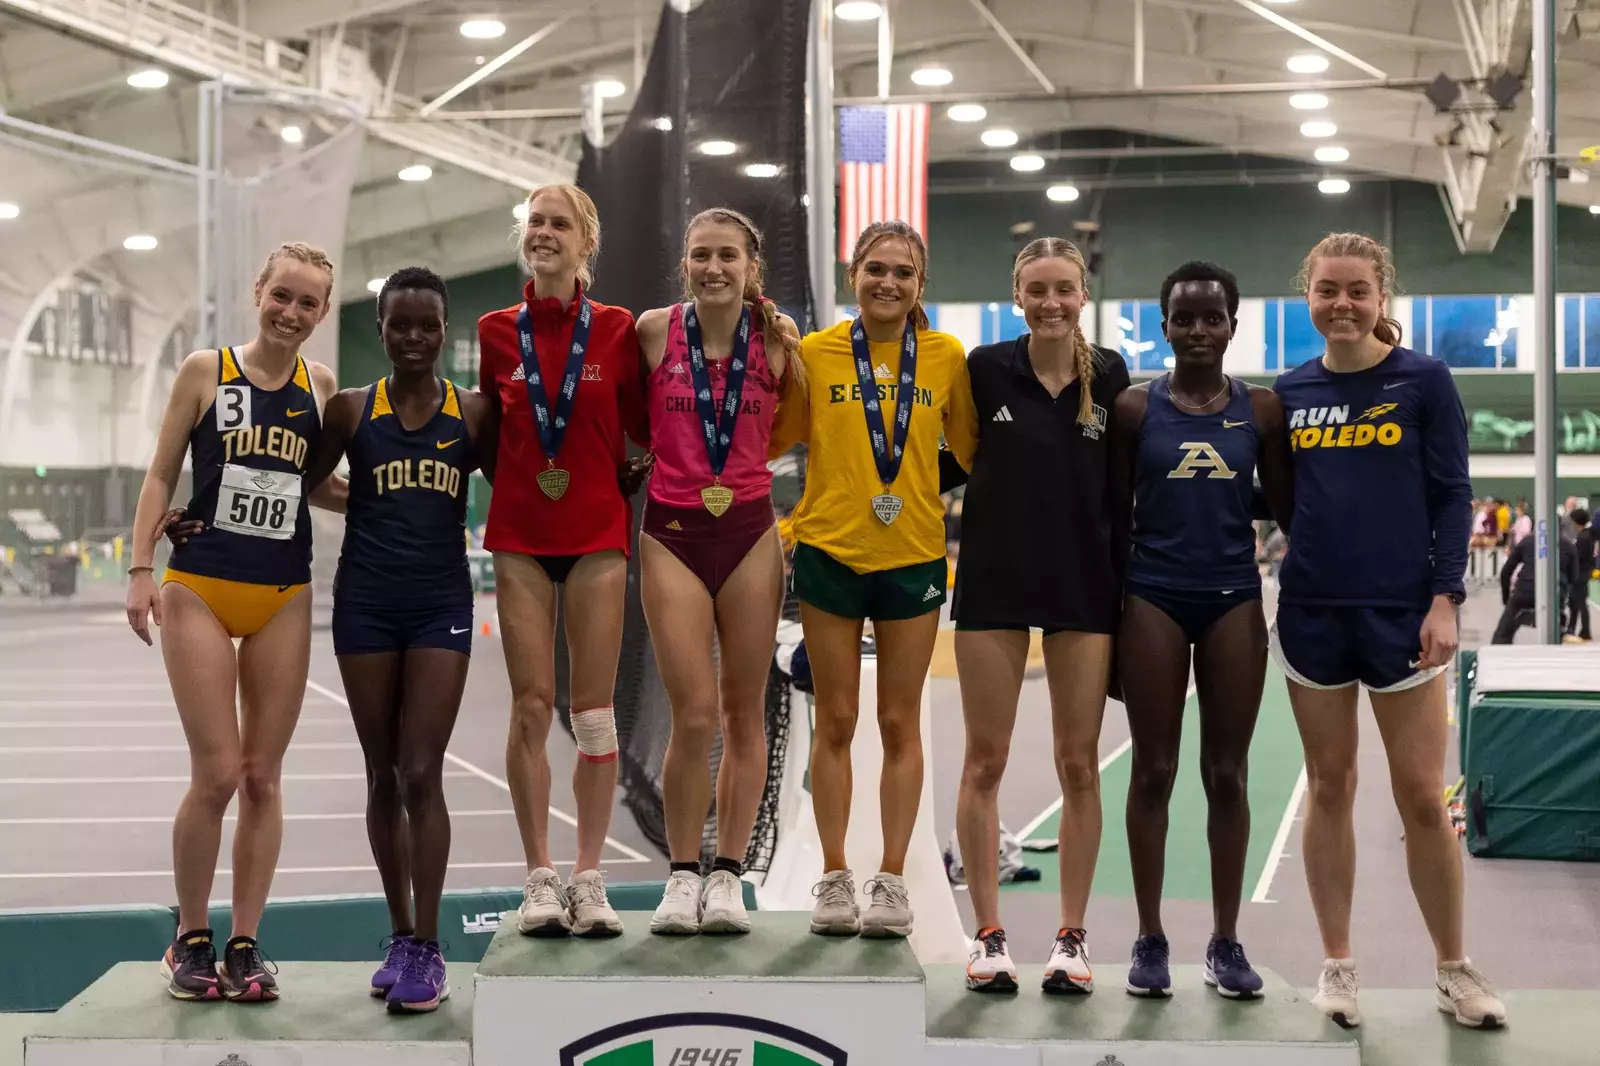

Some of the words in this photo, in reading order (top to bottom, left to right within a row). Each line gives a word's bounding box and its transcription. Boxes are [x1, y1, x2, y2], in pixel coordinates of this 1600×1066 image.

[582, 364, 602, 380] M
[223, 387, 244, 428] 3
[851, 384, 932, 407] ESTRN
[1290, 404, 1350, 429] RUN
[222, 425, 308, 469] TOLEDO
[1290, 422, 1403, 452] TOLEDO
[1166, 441, 1238, 479] A
[373, 458, 460, 499] TOLEDO
[229, 491, 287, 529] 508
[875, 503, 901, 512] MAC
[668, 1047, 743, 1066] 1946
